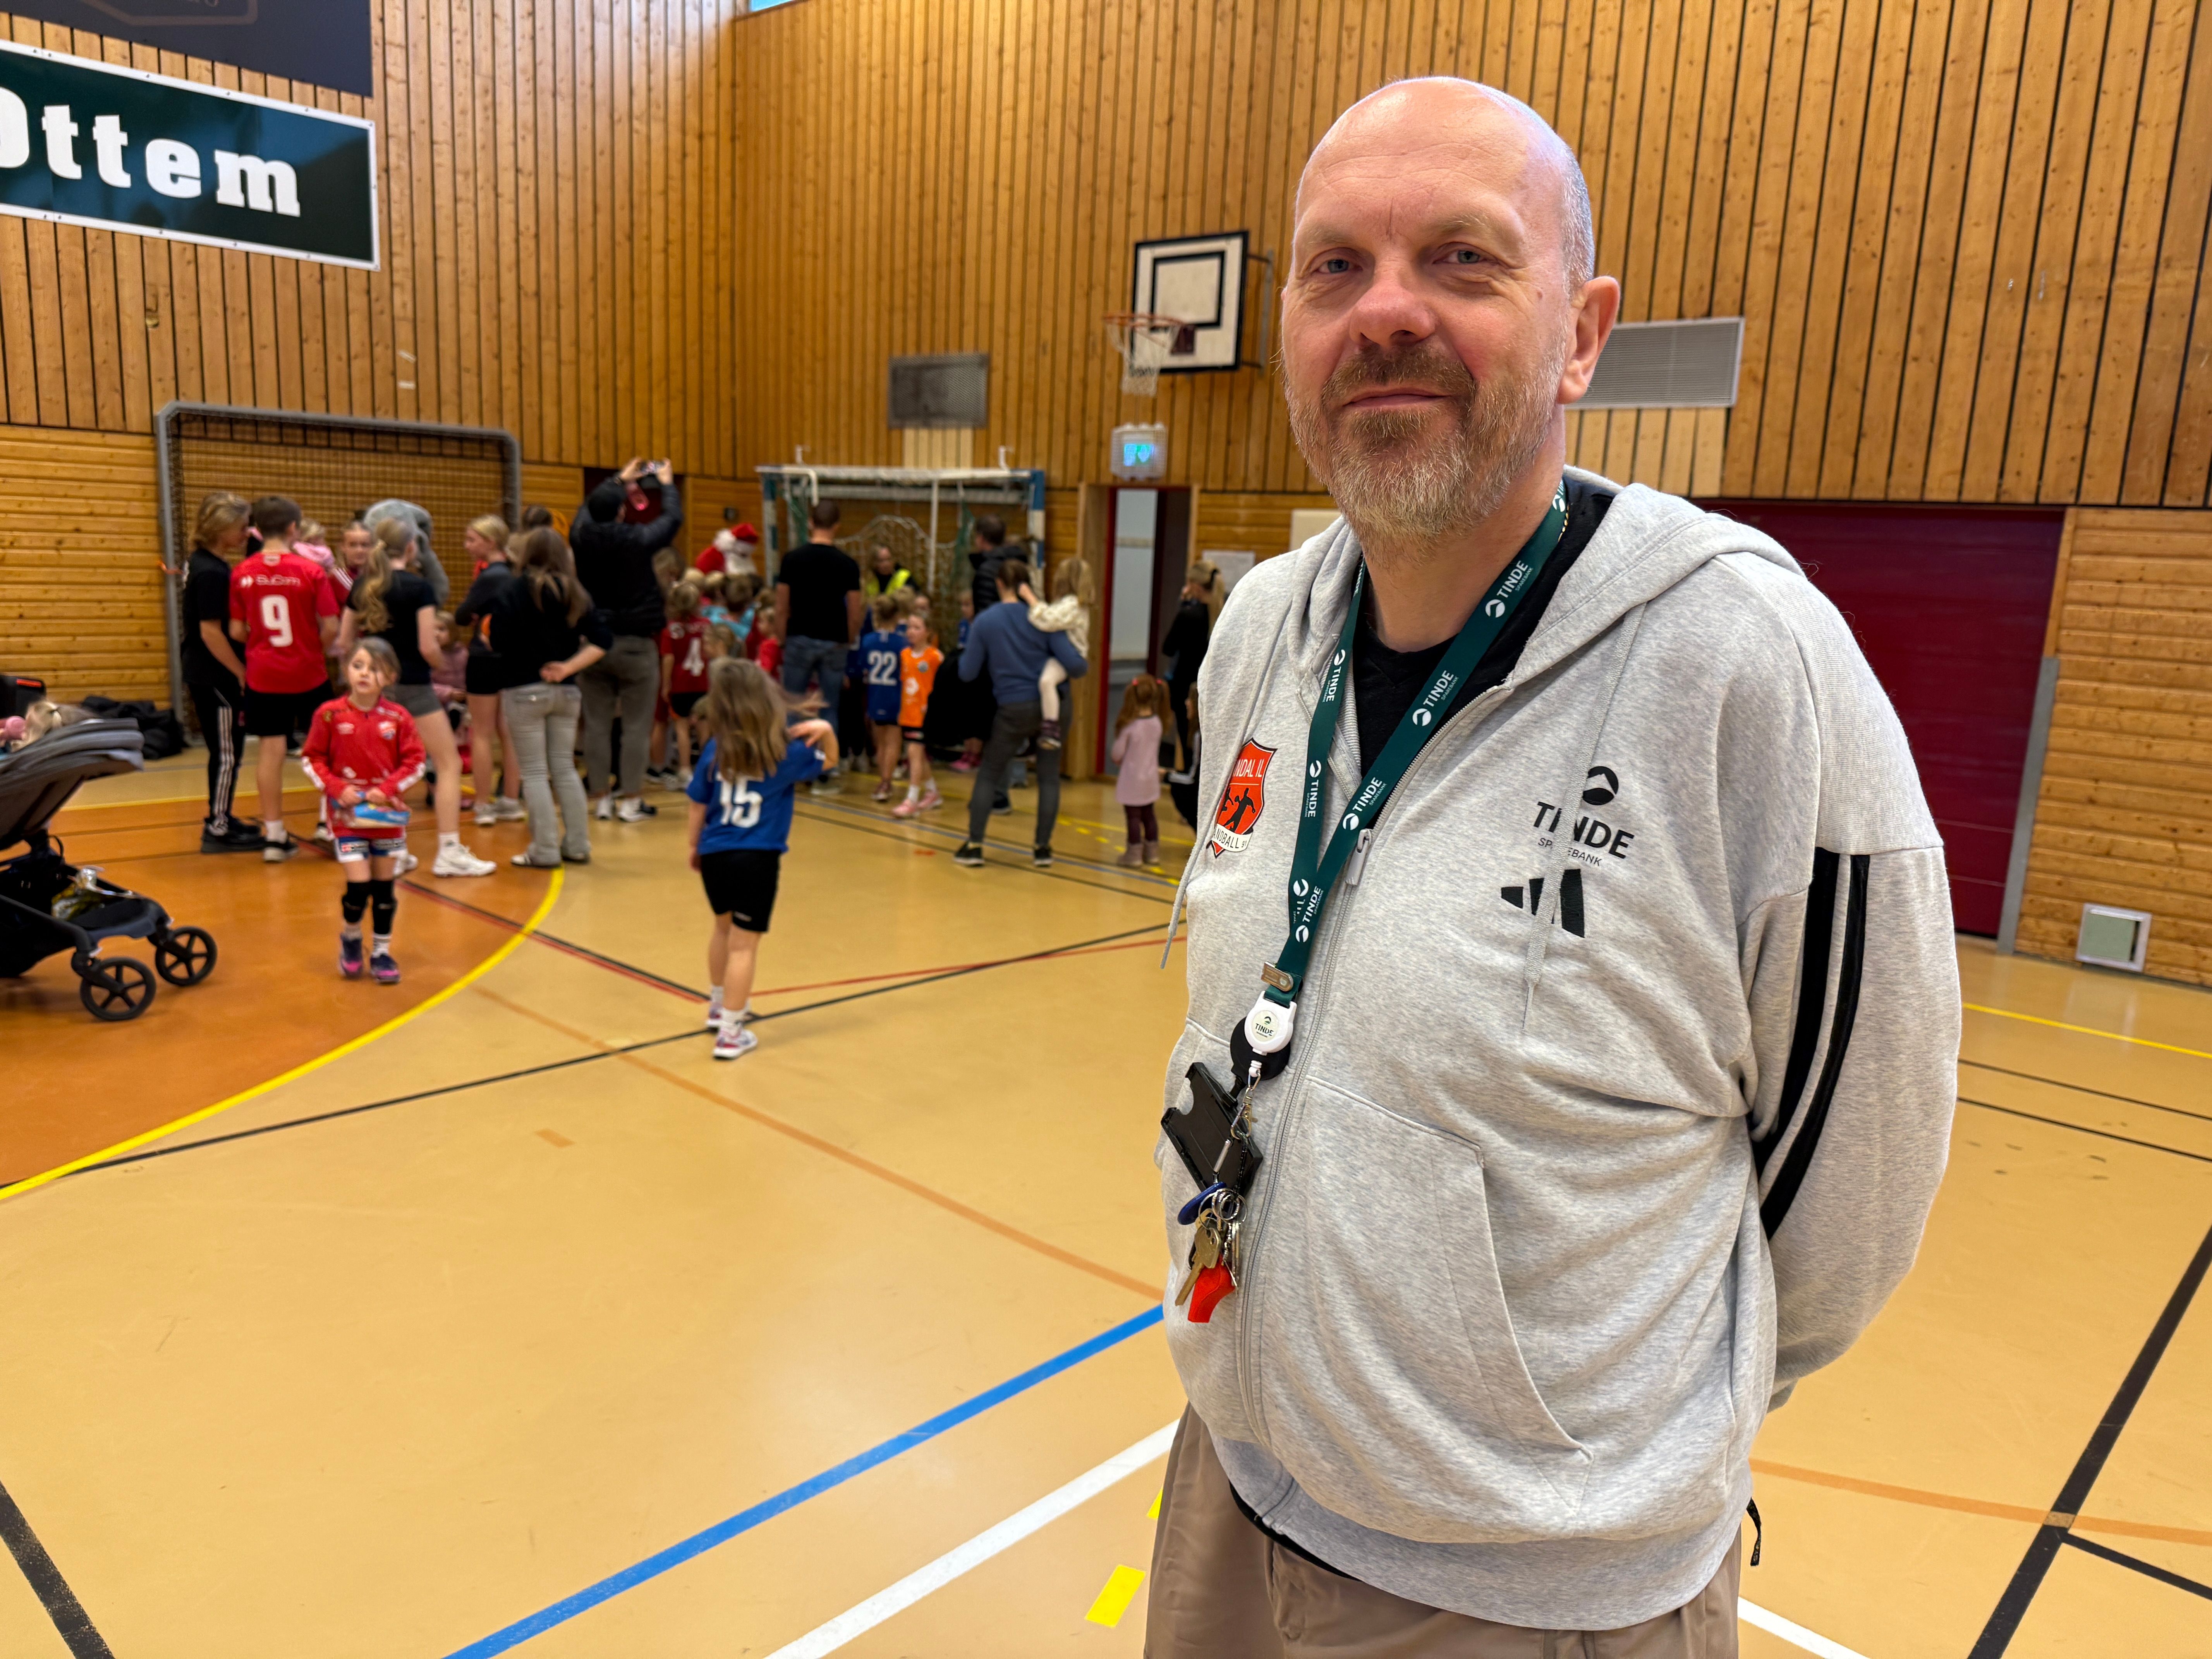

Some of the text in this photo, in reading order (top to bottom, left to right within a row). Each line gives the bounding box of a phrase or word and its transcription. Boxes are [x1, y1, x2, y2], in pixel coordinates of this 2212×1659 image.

[1496, 560, 1528, 598] TINDE
[260, 594, 294, 647] 9
[868, 650, 898, 687] 22
[1326, 666, 1341, 702] TINDE
[1423, 670, 1454, 707] TINDE
[1233, 759, 1264, 778] NDAL IL
[716, 772, 763, 828] 15
[1308, 780, 1319, 817] TINDE
[1352, 777, 1382, 812] TINDE
[1534, 801, 1635, 859] TINDE
[1538, 838, 1602, 866] SPEBANK
[1302, 886, 1321, 922] TINDE
[1255, 1023, 1274, 1036] TINDE
